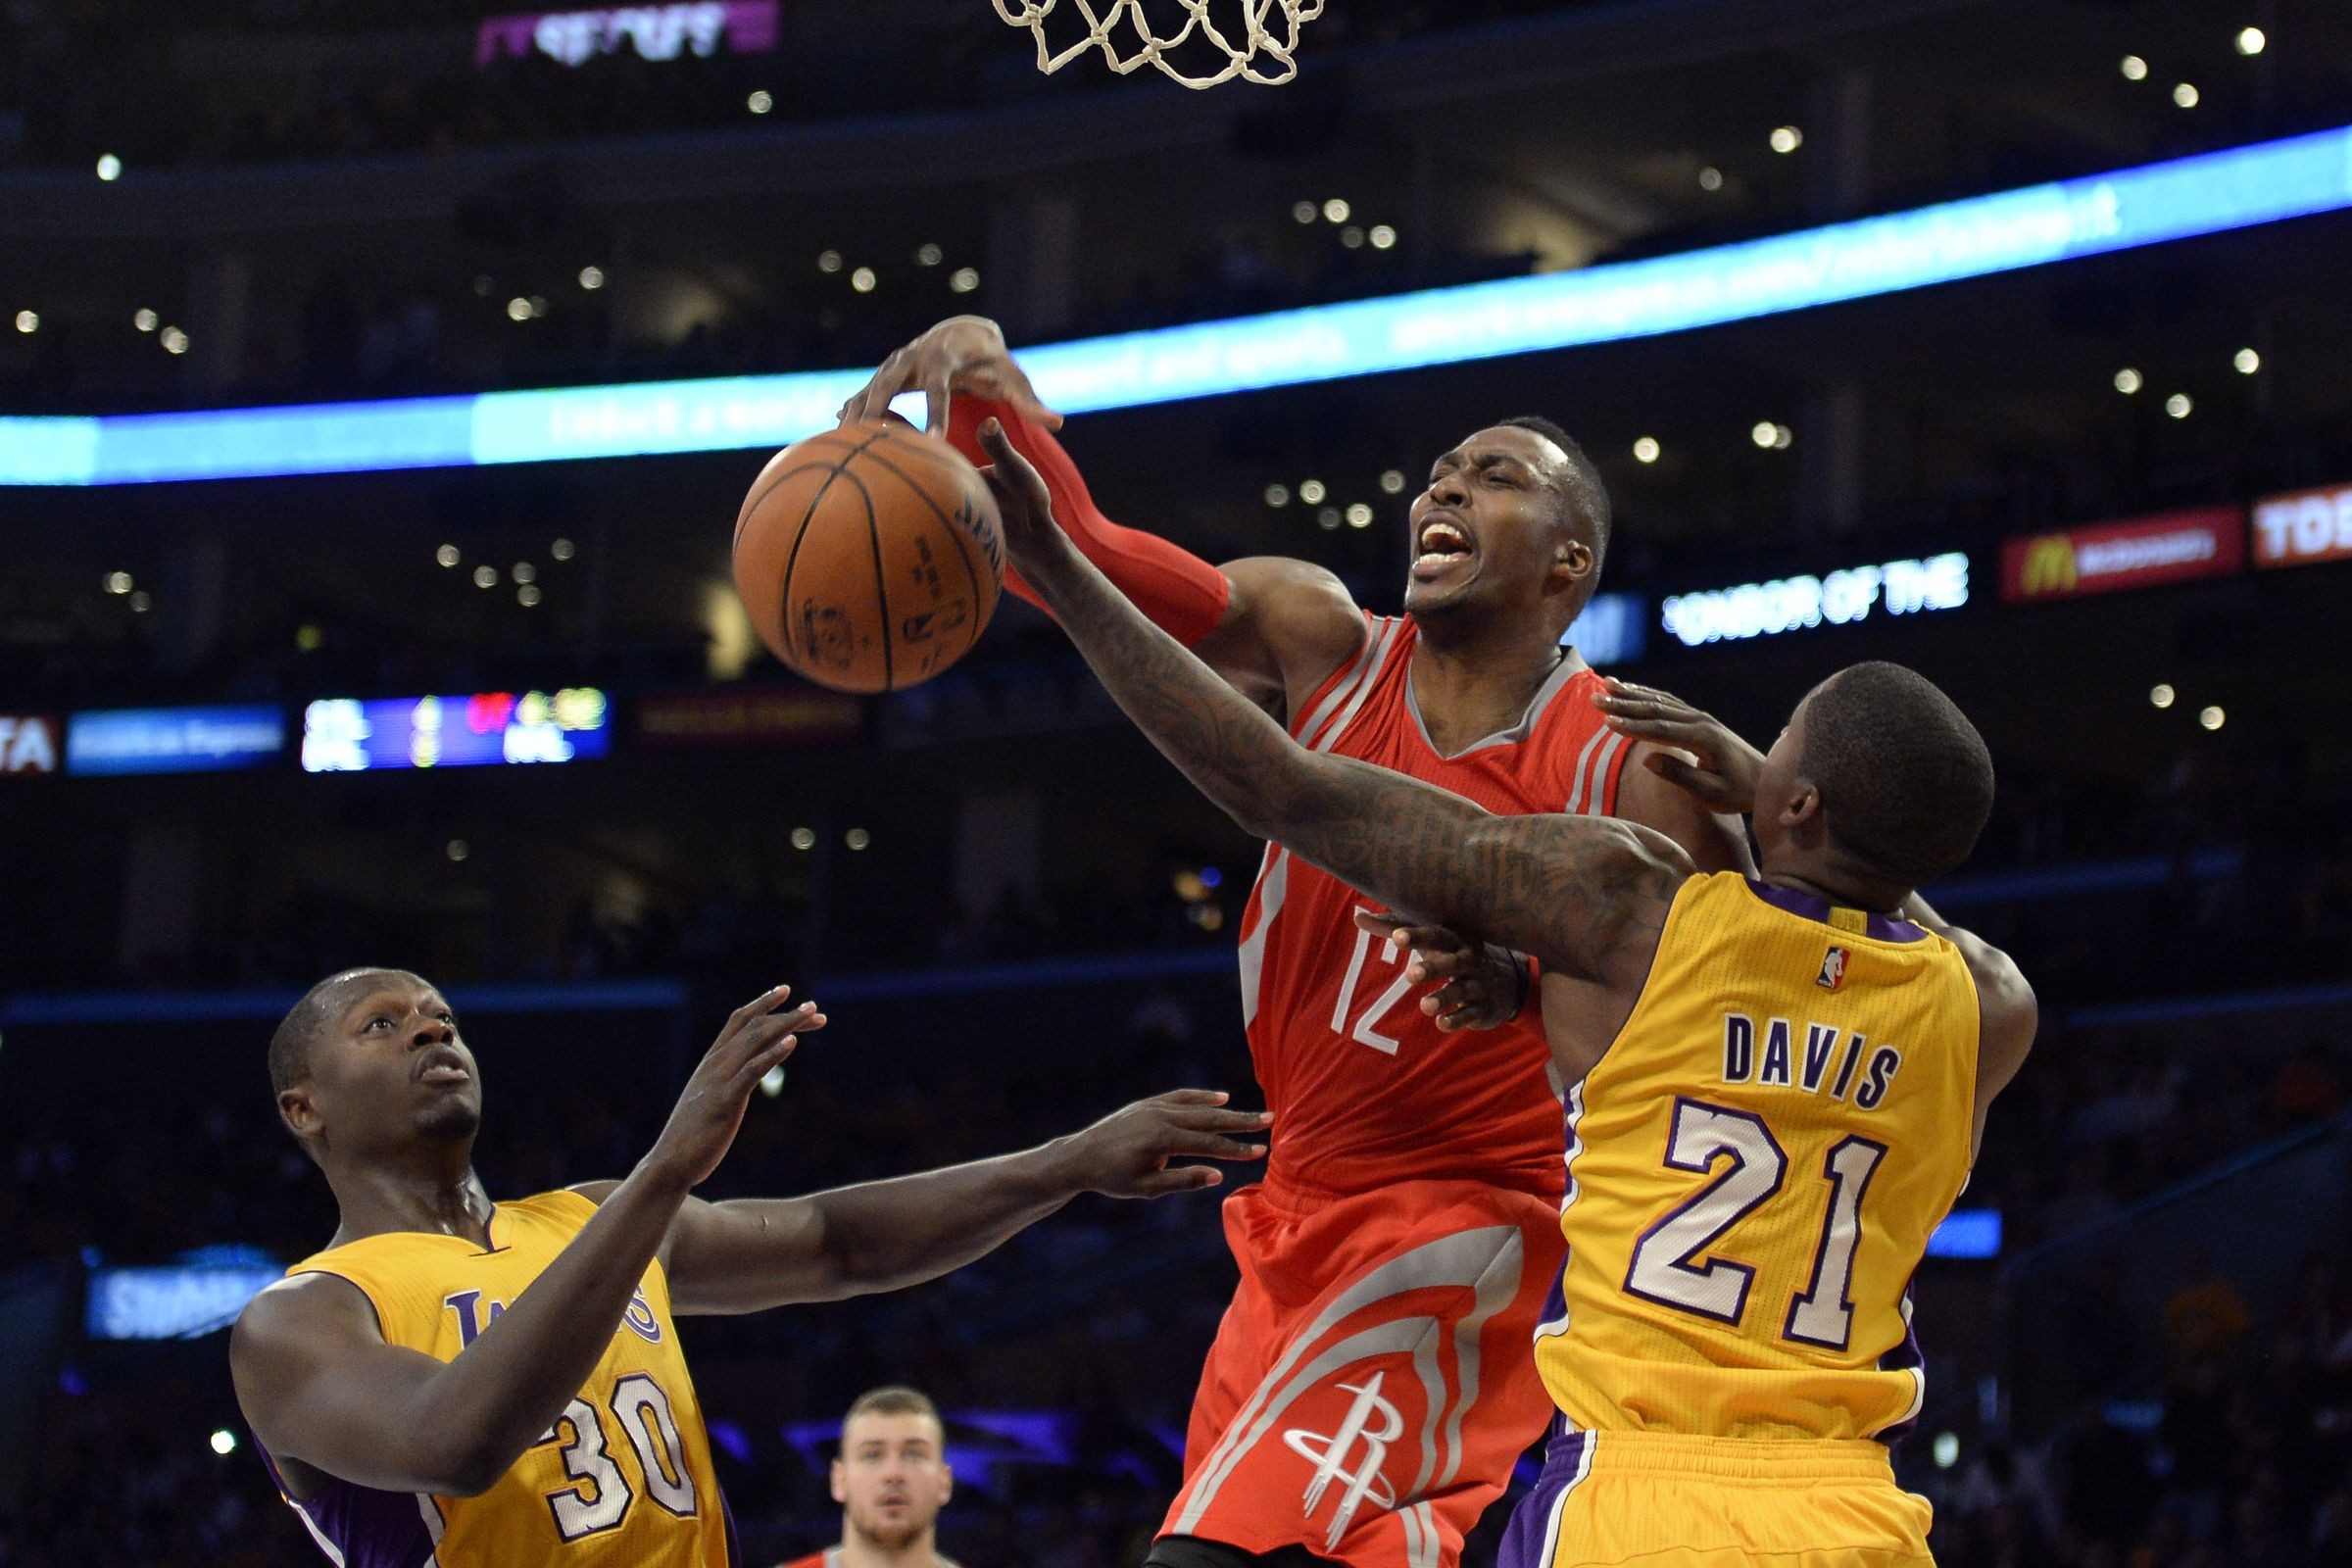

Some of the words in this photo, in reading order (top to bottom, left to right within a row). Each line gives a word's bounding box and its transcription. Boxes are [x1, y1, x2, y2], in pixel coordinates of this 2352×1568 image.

[1880, 552, 1969, 615] THE
[1722, 1012, 1902, 1111] DAVIS
[1621, 1095, 1889, 1353] 21
[530, 1373, 700, 1545] 30
